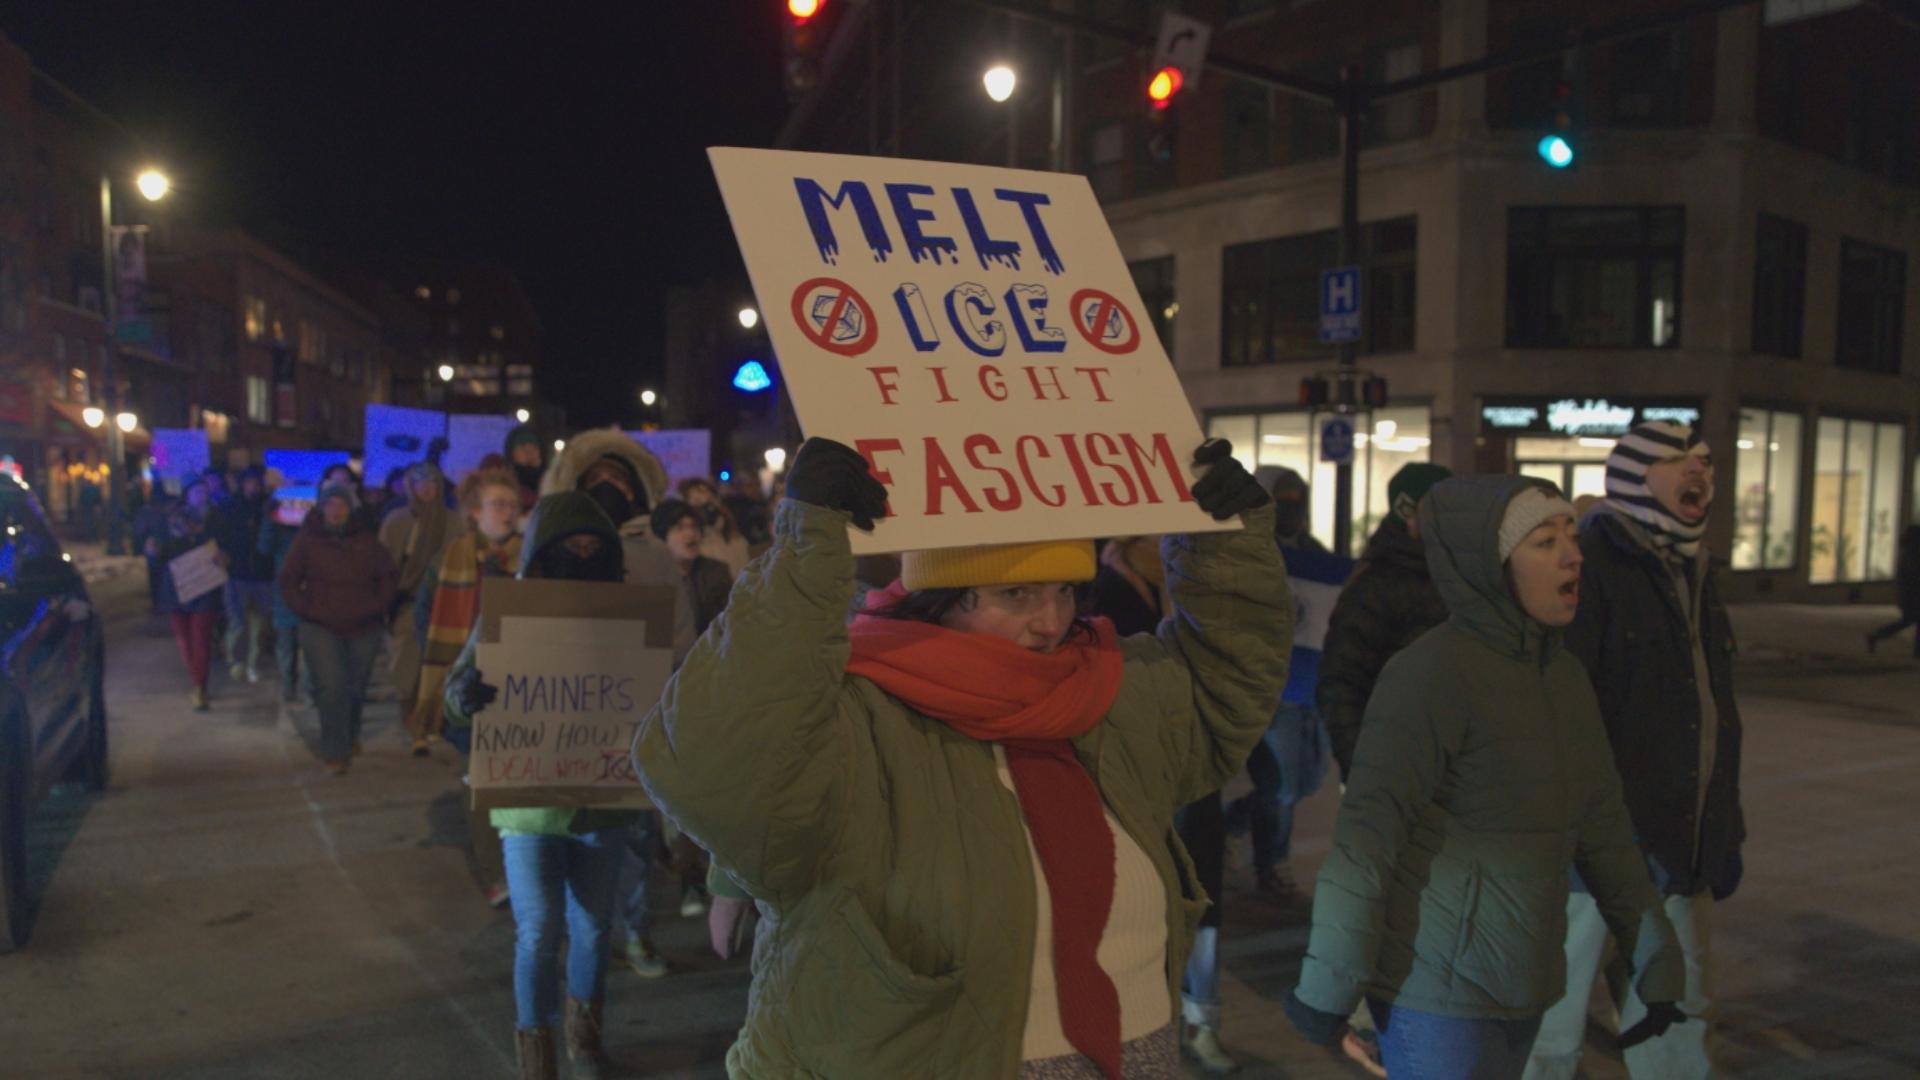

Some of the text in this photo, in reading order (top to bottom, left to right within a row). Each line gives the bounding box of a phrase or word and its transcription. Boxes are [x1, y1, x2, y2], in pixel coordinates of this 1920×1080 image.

[793, 177, 1064, 276] MELT
[1328, 273, 1353, 311] H
[893, 282, 1066, 357] ICE
[867, 365, 1114, 405] FIGHT
[855, 432, 1195, 517] FASCISM
[503, 673, 635, 713] MAINERS
[475, 720, 545, 752] KNOW
[555, 722, 620, 751] HOW
[488, 754, 545, 784] DEAL
